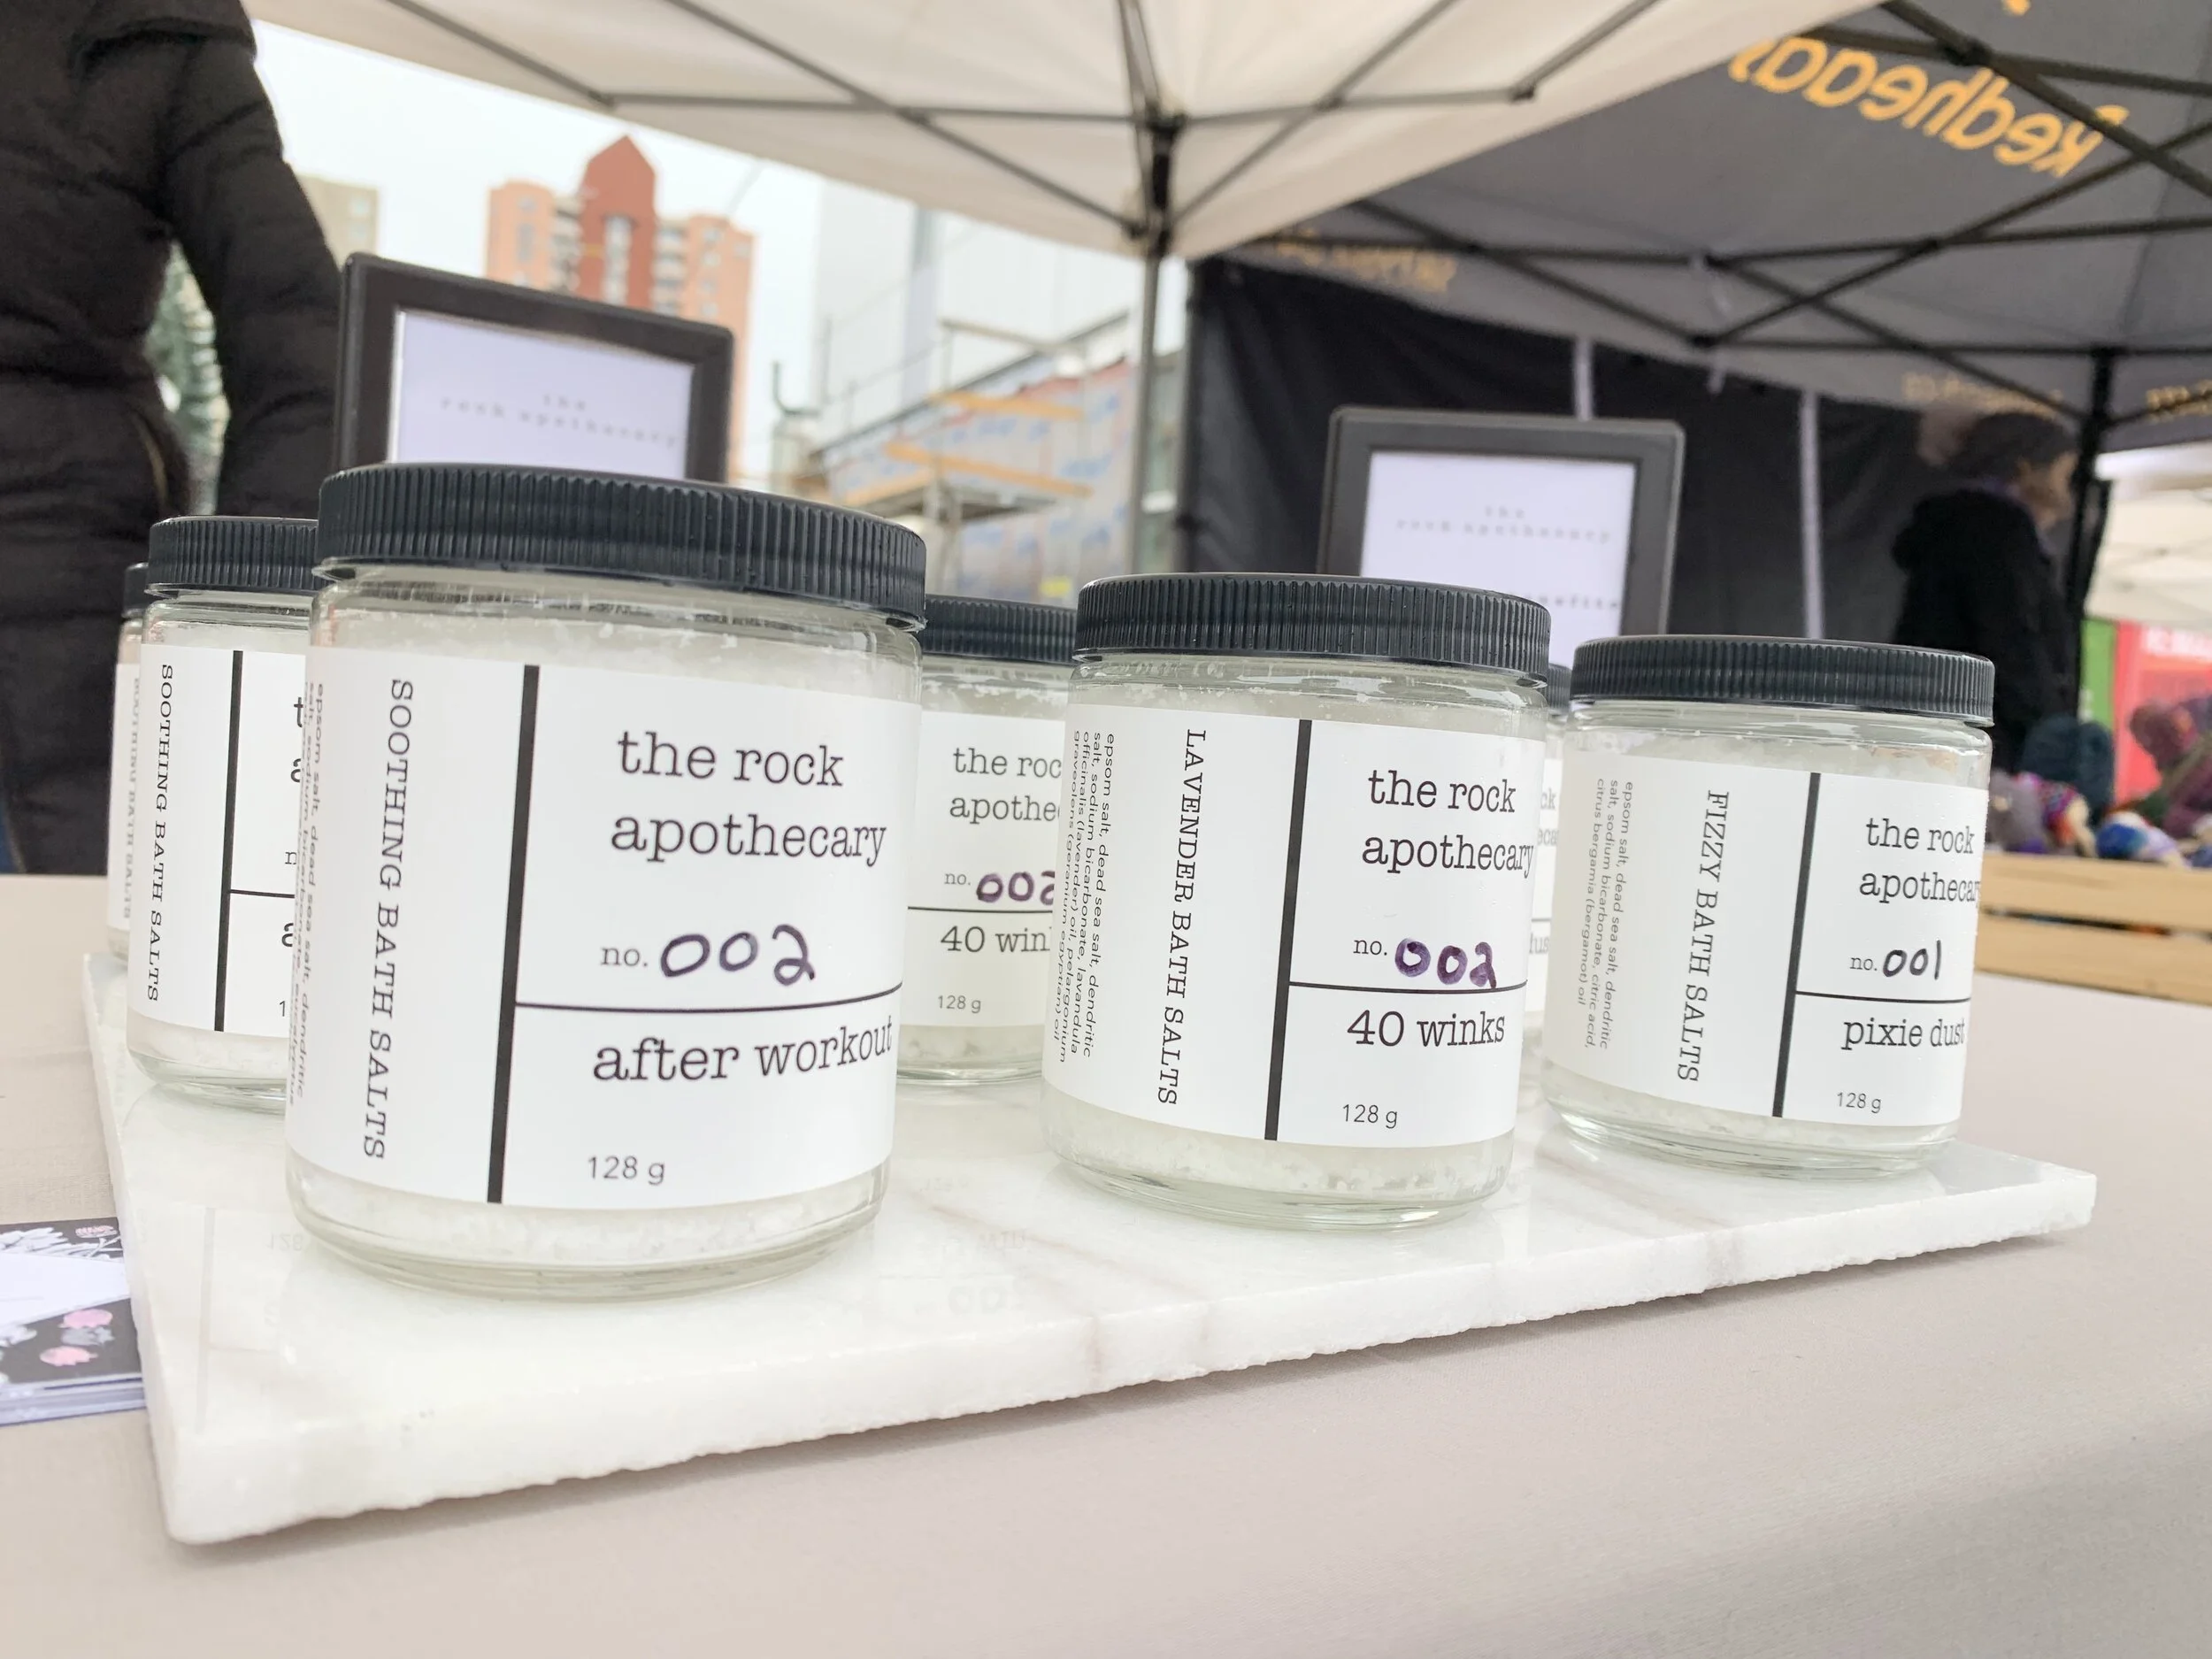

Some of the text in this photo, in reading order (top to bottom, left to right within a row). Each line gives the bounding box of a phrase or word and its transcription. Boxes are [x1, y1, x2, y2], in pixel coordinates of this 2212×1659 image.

[315, 683, 324, 765] epsom
[618, 730, 844, 787] the rock
[953, 747, 1063, 780] the roc
[1069, 730, 1080, 829] graveolens
[949, 795, 1060, 825] apothe
[1368, 769, 1517, 814] the rock
[147, 664, 173, 1002] SOOTHING BATH SALTS
[309, 825, 319, 887] dead
[611, 813, 887, 868] apothecary
[1362, 834, 1535, 879] apothecary
[1865, 817, 1976, 855] the rock
[944, 872, 972, 887] no.
[1059, 731, 1091, 1064] officinalis (lavender) oil, pelargonium
[1061, 833, 1074, 926] (geranium
[1071, 732, 1102, 1055] salt, sodium bicarbonate, lavandula
[1083, 733, 1115, 1058] epsom salt, dead sea salt, dendritic
[1578, 778, 1605, 1006] citrus bergamia (bergamot) oil
[363, 679, 414, 1159] SOOTHING BATH SALTS
[941, 925, 1052, 954] 40 win
[1157, 728, 1207, 1105] LAVENDER BATH SALTS
[1584, 780, 1618, 1048] salt, sodium bicarbonate, citric acid,
[1600, 780, 1633, 1050] epsom salt, dead sea salt, dendritic
[1677, 789, 1730, 1082] FIZZY BATH SALTS
[600, 924, 817, 987] no. 002
[1352, 937, 1498, 990] no. 002
[1848, 939, 1942, 980] no. 001
[937, 995, 982, 1015] 128 g
[1346, 1009, 1506, 1048] 40 winks
[1840, 1016, 1966, 1051] pixie dust
[296, 992, 311, 1100] dendritic
[593, 1014, 894, 1081] after workout
[1341, 1103, 1399, 1130] 128 g
[1836, 1091, 1883, 1114] 128 g
[588, 1155, 666, 1187] 128 g
